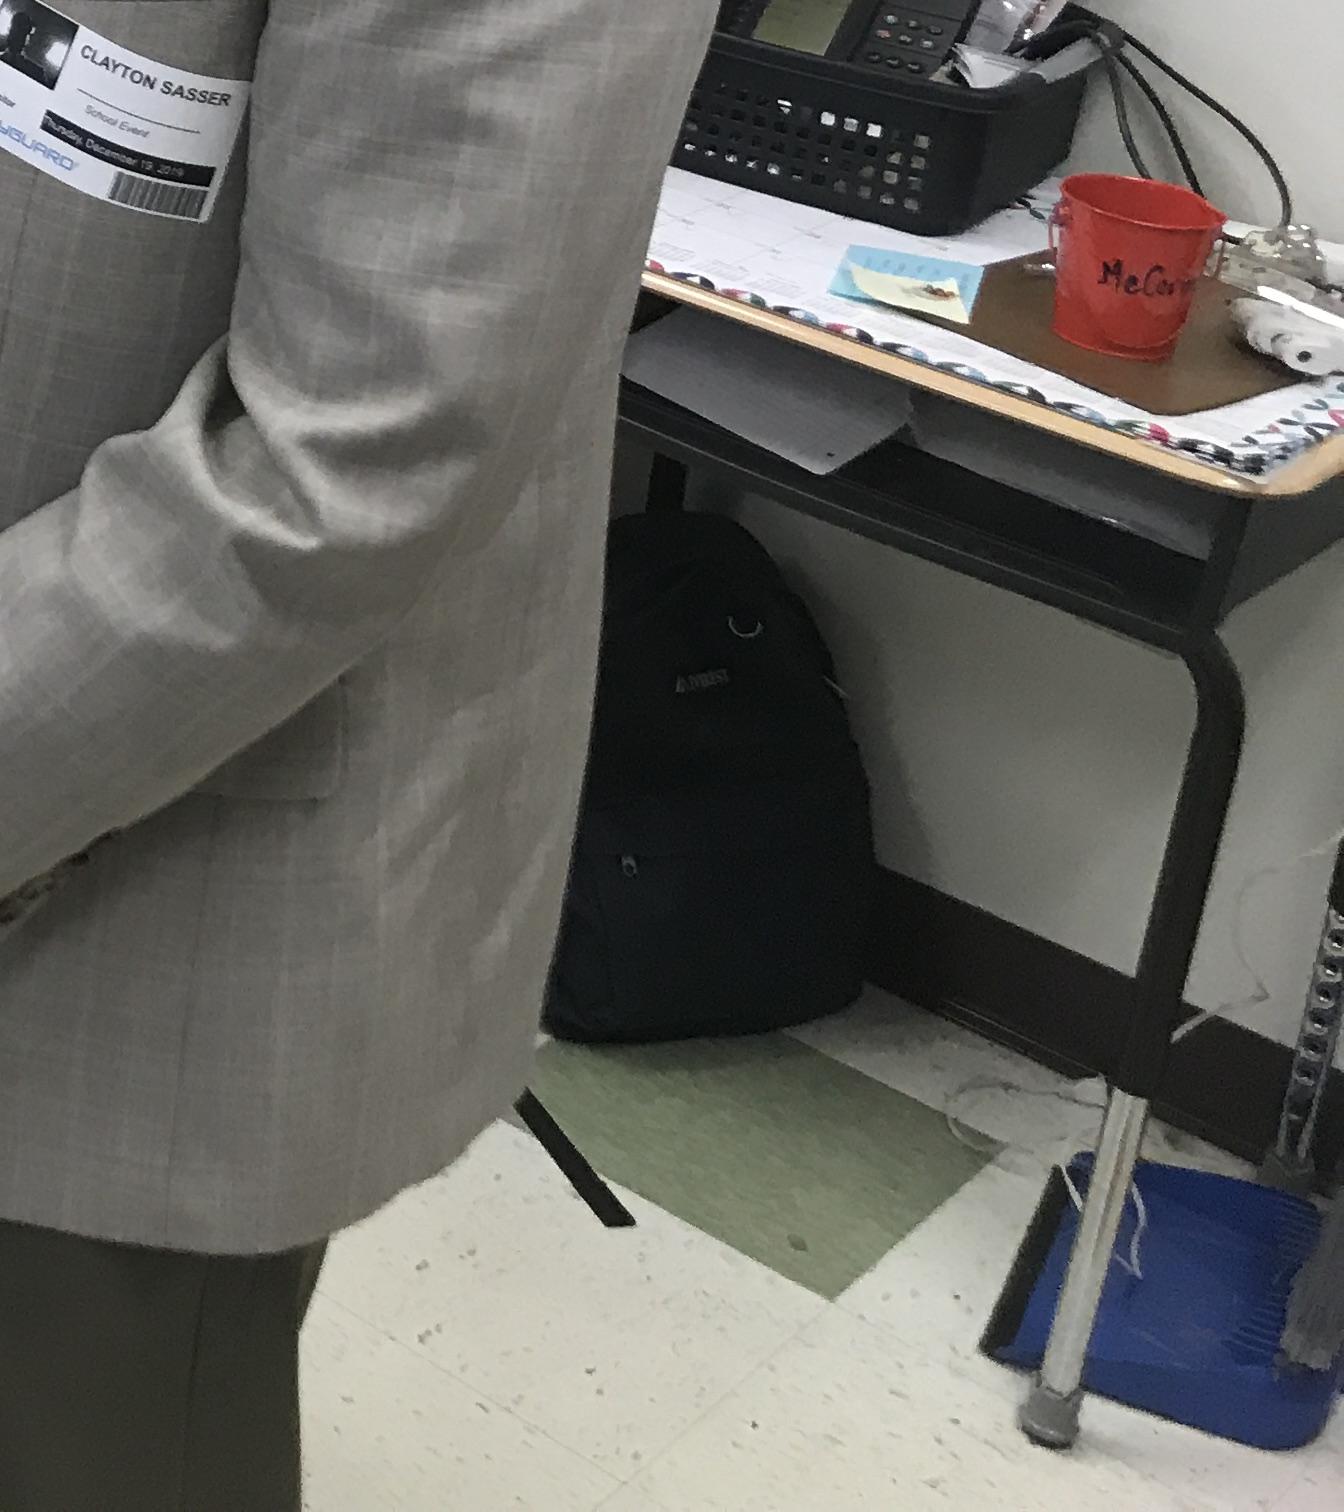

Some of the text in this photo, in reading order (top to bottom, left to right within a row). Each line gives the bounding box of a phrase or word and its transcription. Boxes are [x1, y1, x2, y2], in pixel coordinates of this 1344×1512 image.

[80, 44, 232, 107] CLAYTON SASSER
[84, 104, 119, 127] School
